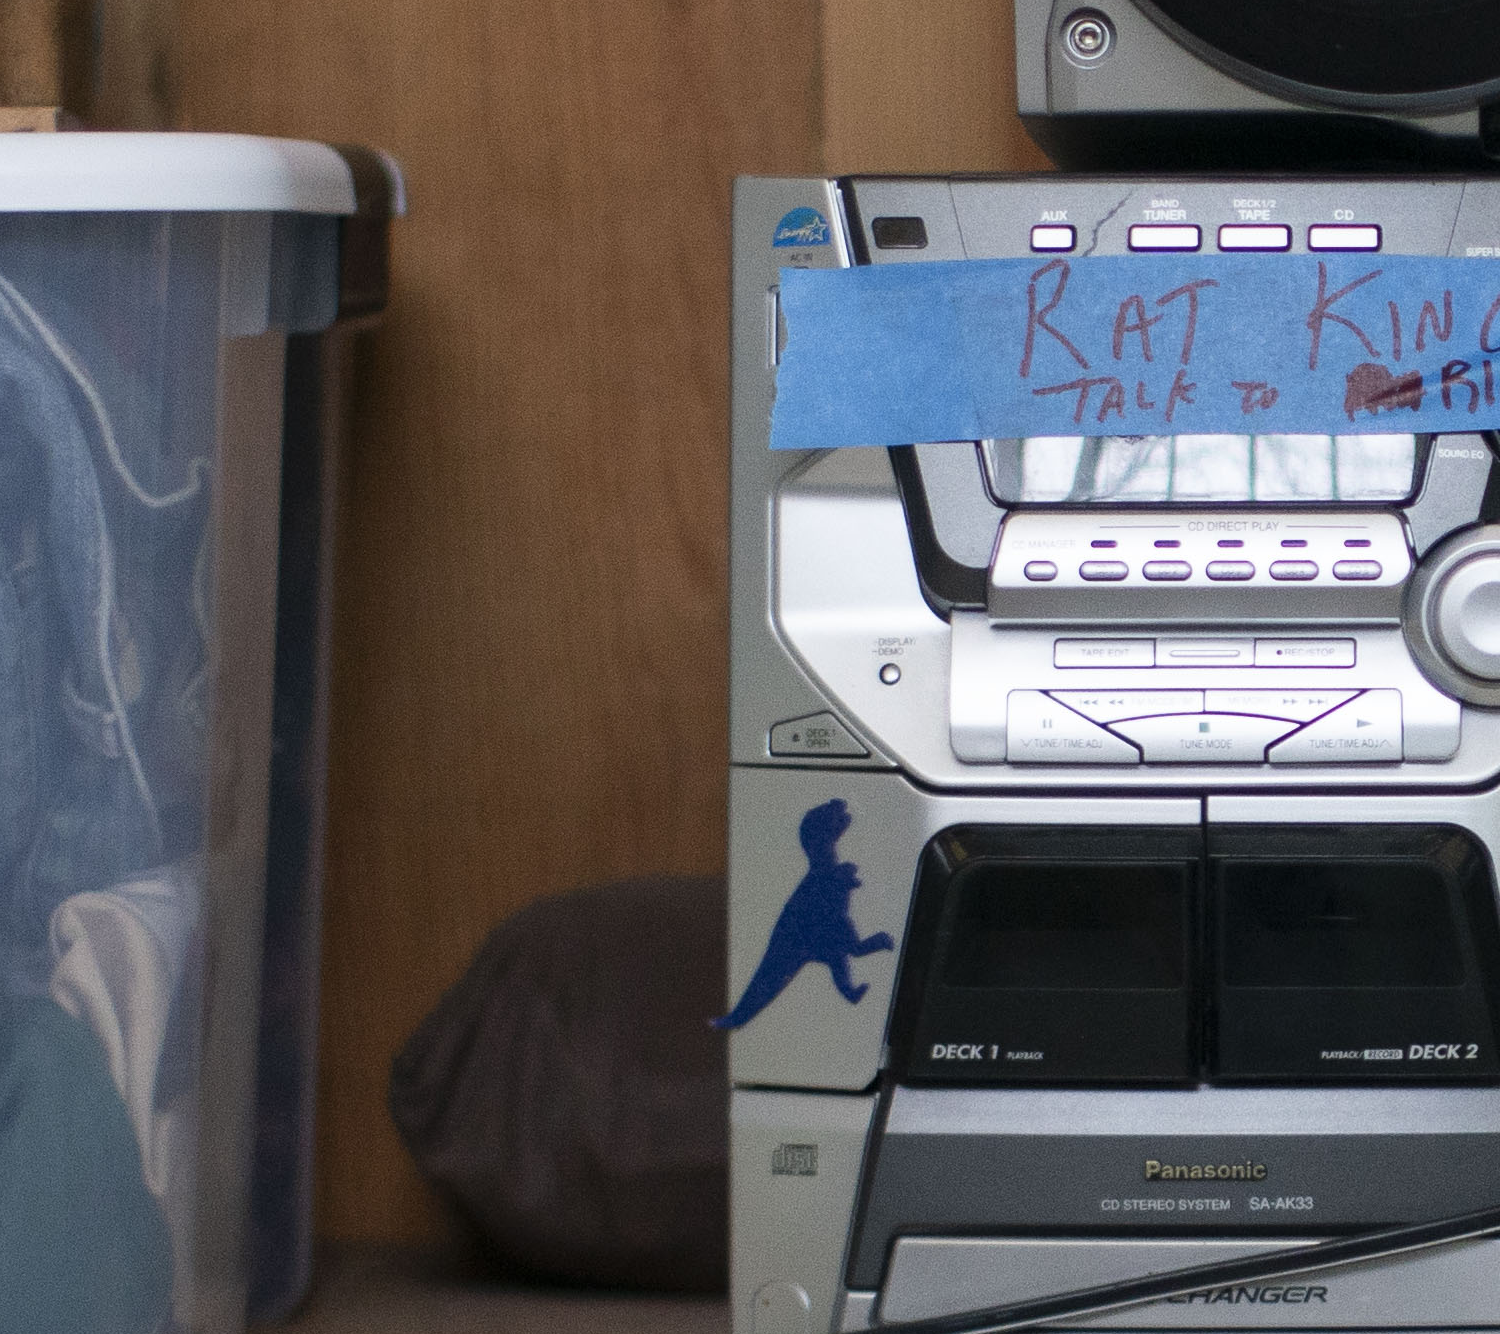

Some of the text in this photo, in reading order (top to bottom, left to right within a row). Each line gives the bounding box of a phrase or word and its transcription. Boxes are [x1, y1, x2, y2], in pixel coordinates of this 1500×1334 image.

[1151, 199, 1180, 208] BAND
[1041, 210, 1068, 221] AUX
[1143, 210, 1187, 221] TUNER
[1238, 209, 1271, 221] TAPE
[1334, 209, 1355, 221] CD
[1466, 247, 1493, 257] SUPER
[1019, 258, 1221, 378] RAT
[1032, 368, 1197, 424] TALK
[1231, 380, 1280, 415] TO
[1470, 450, 1485, 459] EQ
[1188, 521, 1280, 532] CD DIRECT PLAY
[1180, 738, 1234, 749] TUNE MODE
[932, 1043, 1000, 1060] DECK 1
[1409, 1043, 1479, 1060] DECK 2
[1145, 1159, 1267, 1180] Panasonic
[1101, 1196, 1315, 1211] CD STEREO SYSTEM SA-AK33
